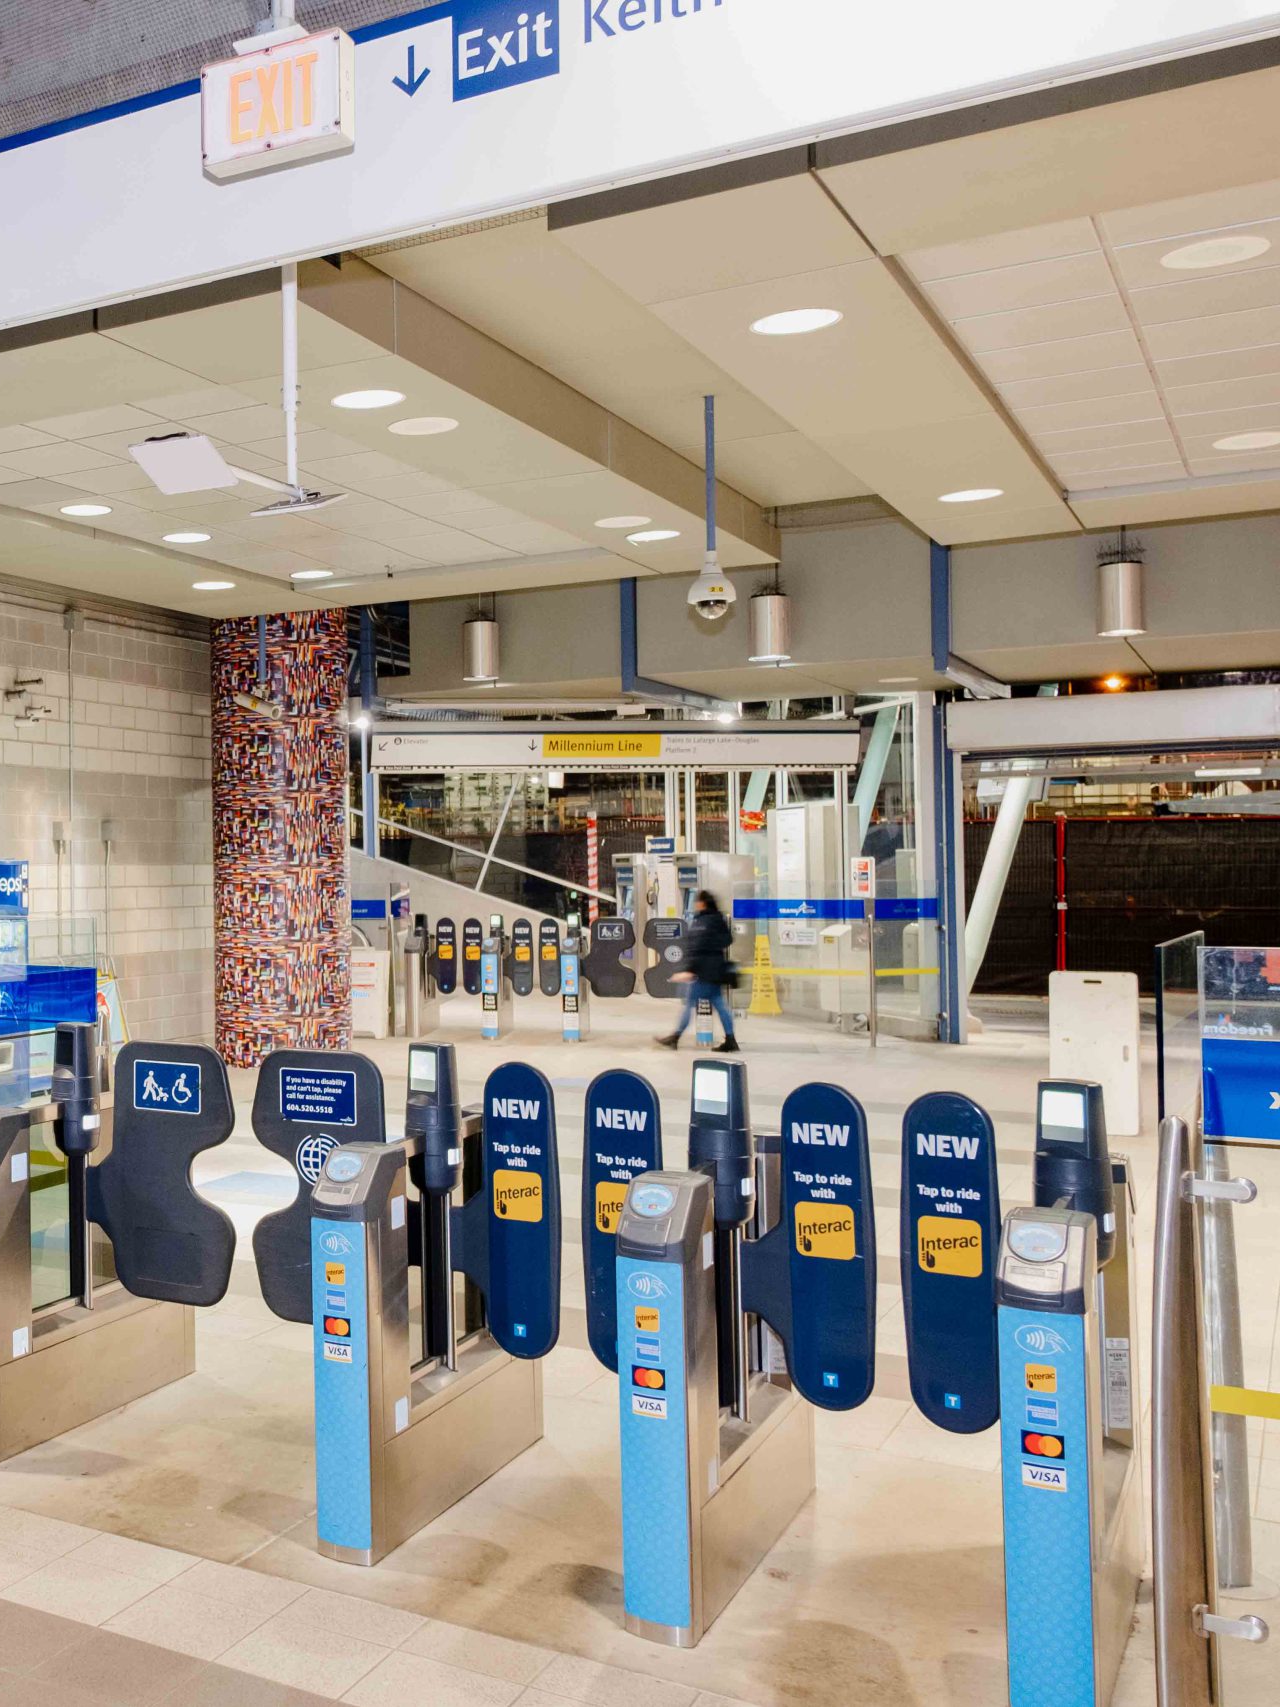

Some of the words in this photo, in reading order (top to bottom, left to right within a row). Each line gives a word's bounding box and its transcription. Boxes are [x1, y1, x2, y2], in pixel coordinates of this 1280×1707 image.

[457, 13, 553, 81] Exit
[229, 52, 318, 145] EXIT
[548, 739, 614, 752] Millennium
[618, 739, 643, 752] Line
[438, 926, 453, 934] NEW
[465, 926, 480, 934] NEW
[514, 926, 530, 935] NEW
[541, 925, 557, 934] NEW
[321, 1078, 347, 1087] disability
[305, 1093, 336, 1102] assistance.
[286, 1104, 333, 1114] 604.520.5518
[492, 1098, 540, 1121] NEW
[596, 1107, 647, 1132] NEW
[791, 1122, 850, 1147] NEW
[492, 1142, 509, 1155] Tap
[510, 1144, 521, 1155] to
[522, 1144, 541, 1156] ride
[916, 1133, 980, 1160] NEW
[507, 1156, 527, 1168] with
[596, 1153, 613, 1166] Tap
[615, 1155, 626, 1166] to
[627, 1155, 647, 1168] ride
[610, 1169, 633, 1180] with
[793, 1171, 814, 1184] Tap
[815, 1173, 828, 1185] to
[829, 1173, 852, 1187] ride
[496, 1185, 540, 1201] Interac
[810, 1187, 836, 1200] with
[916, 1184, 938, 1198] Tap
[940, 1186, 954, 1199] to
[955, 1187, 981, 1201] ride
[598, 1200, 623, 1214] Inte
[935, 1201, 962, 1214] with
[798, 1219, 852, 1236] Interac
[921, 1235, 979, 1252] Interac
[327, 1346, 348, 1357] VISA
[637, 1400, 662, 1413] VISA
[1028, 1469, 1061, 1484] VISA
